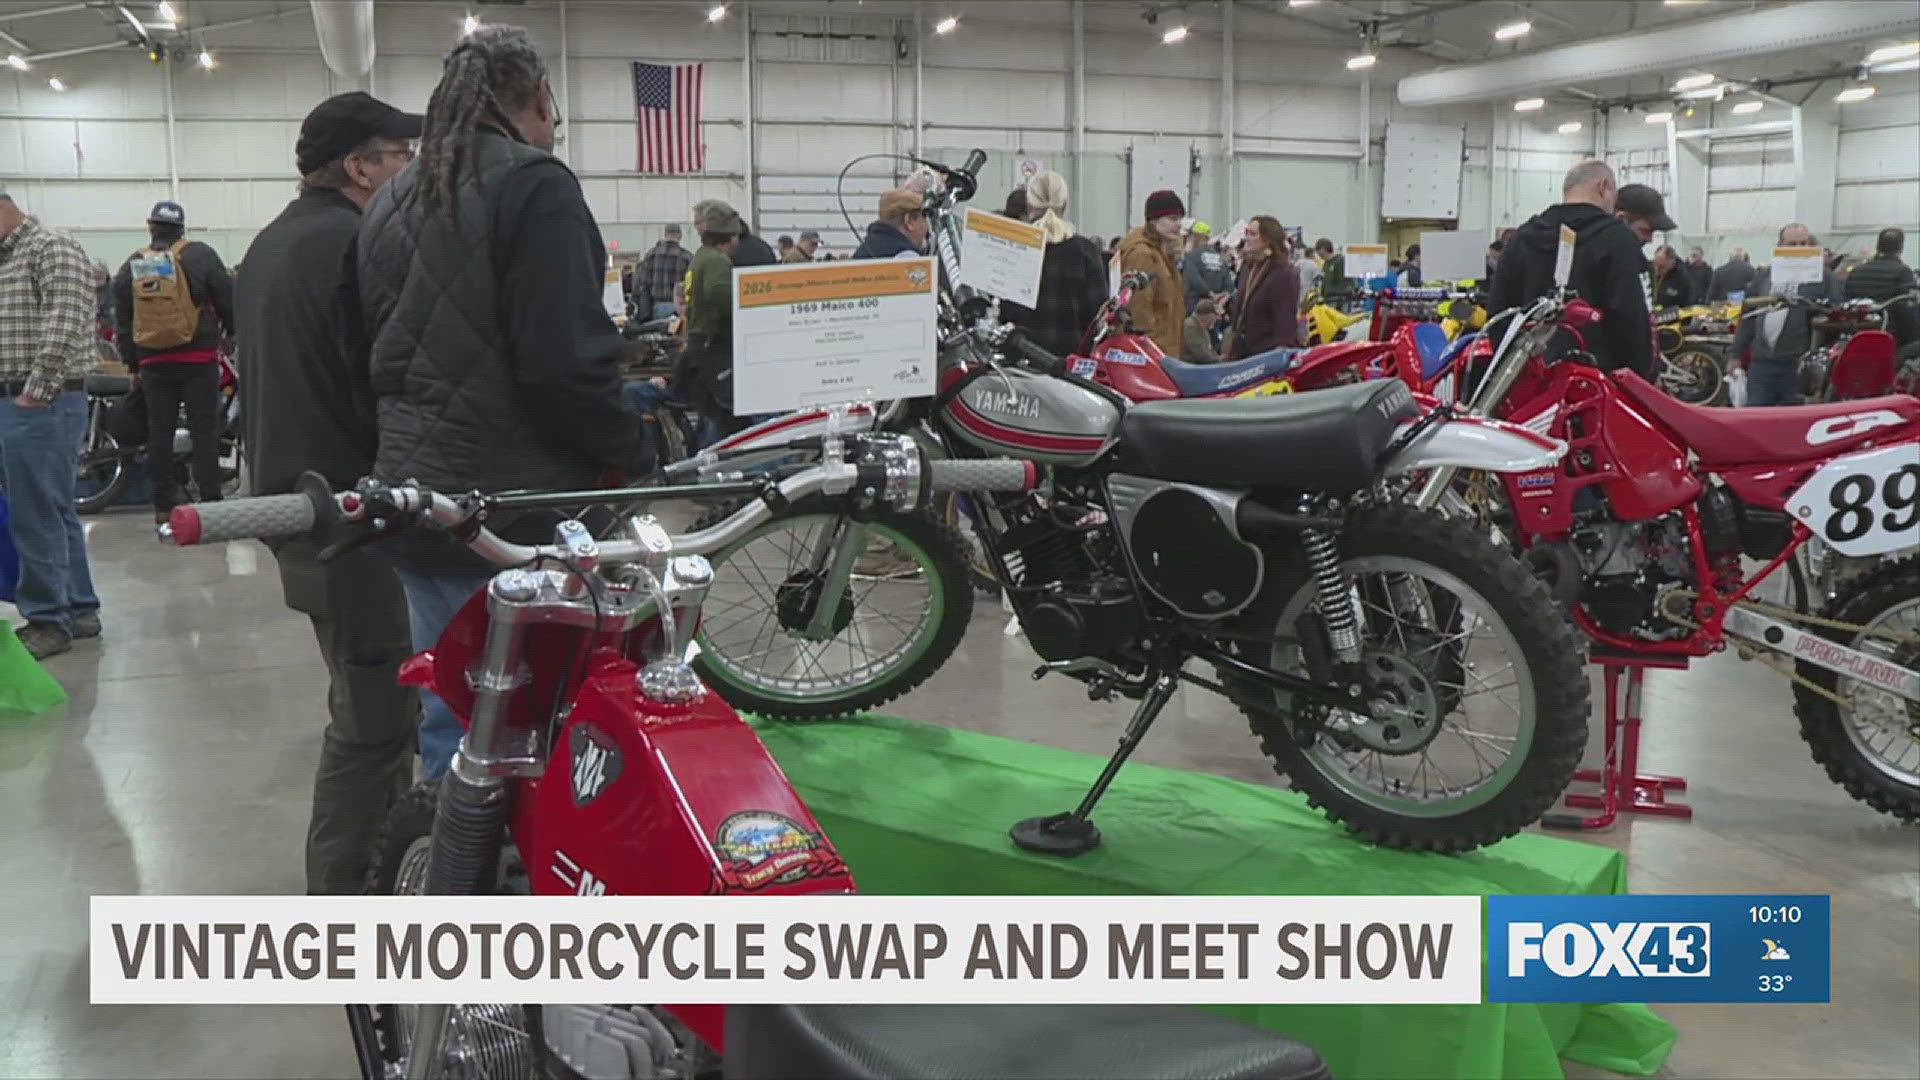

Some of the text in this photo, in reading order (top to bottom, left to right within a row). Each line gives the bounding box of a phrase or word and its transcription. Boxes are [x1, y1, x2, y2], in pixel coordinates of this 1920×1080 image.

[743, 280, 773, 296] 2026
[790, 297, 880, 315] 1969 Maico 400
[975, 389, 1040, 419] YAMHA
[1825, 463, 1920, 542] 89
[1795, 634, 1908, 690] PRO-LINK
